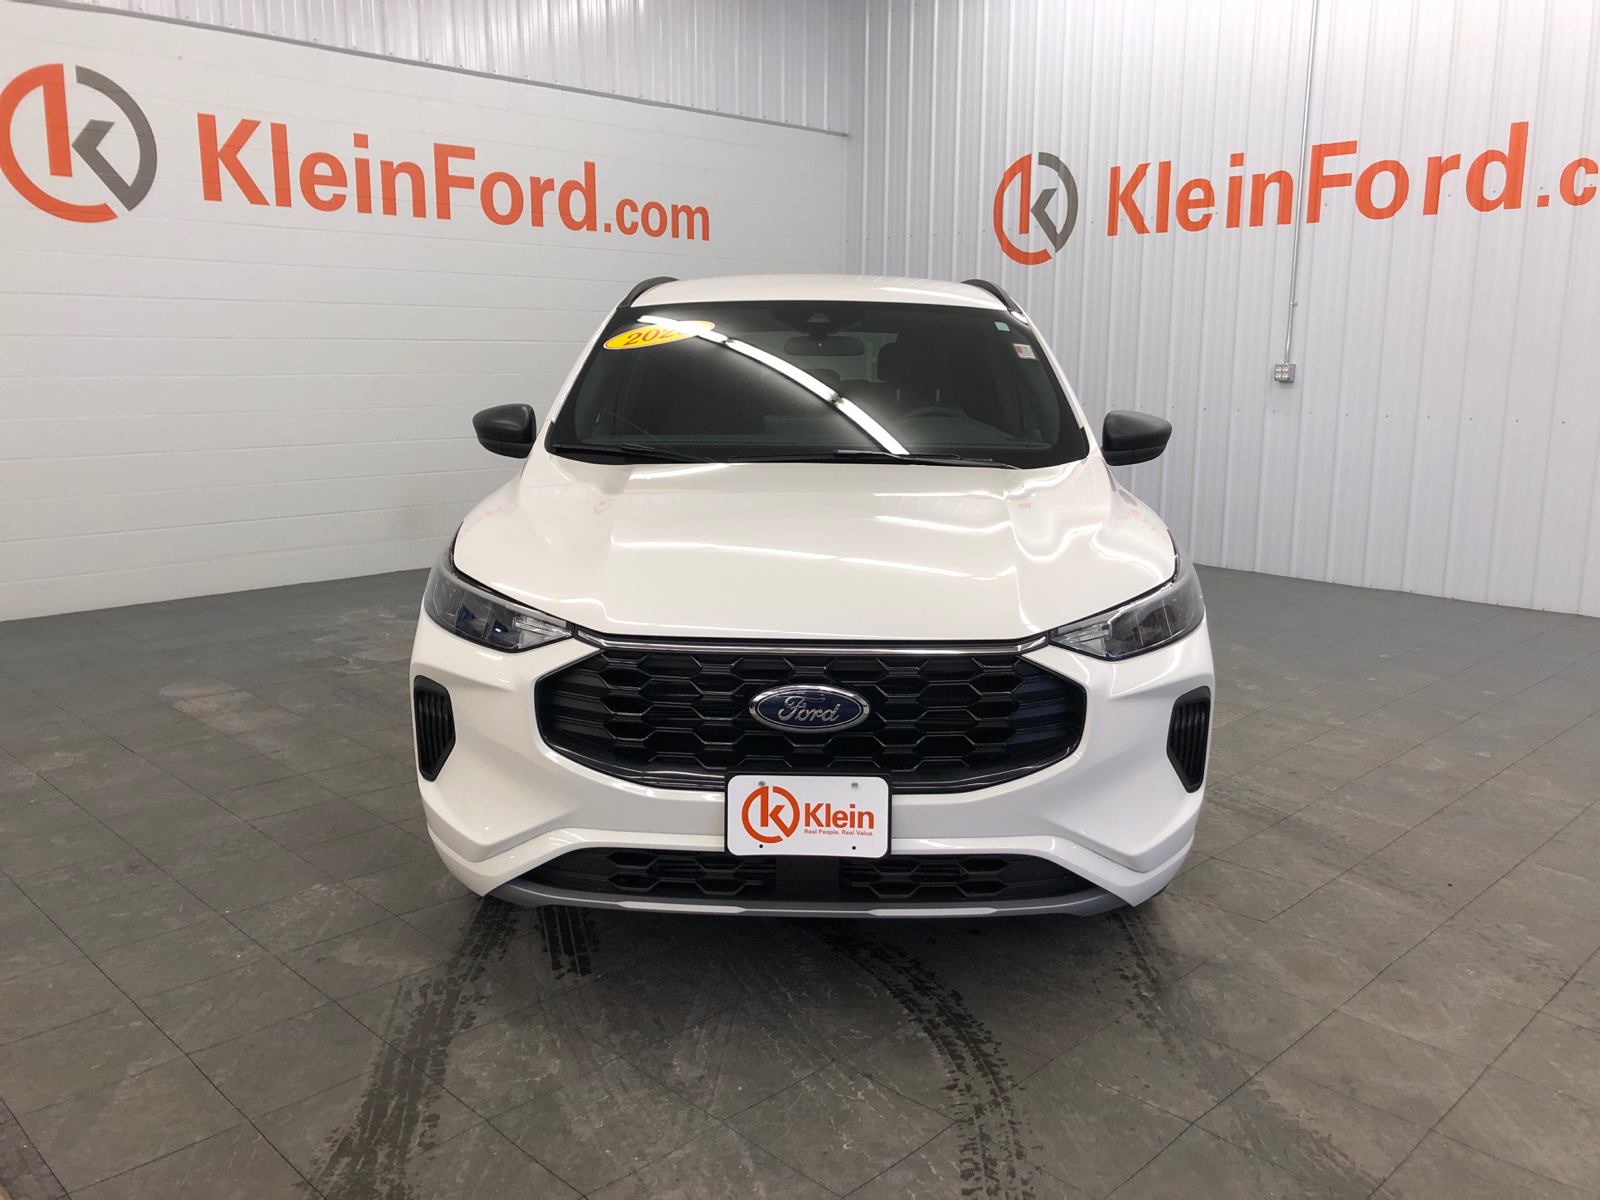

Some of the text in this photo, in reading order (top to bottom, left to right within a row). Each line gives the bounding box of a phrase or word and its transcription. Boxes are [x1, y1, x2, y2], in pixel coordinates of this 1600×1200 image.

[197, 112, 709, 241] KleinFord.com
[778, 696, 840, 721] Ford
[804, 802, 874, 829] Klein
[855, 829, 875, 837] Value.
